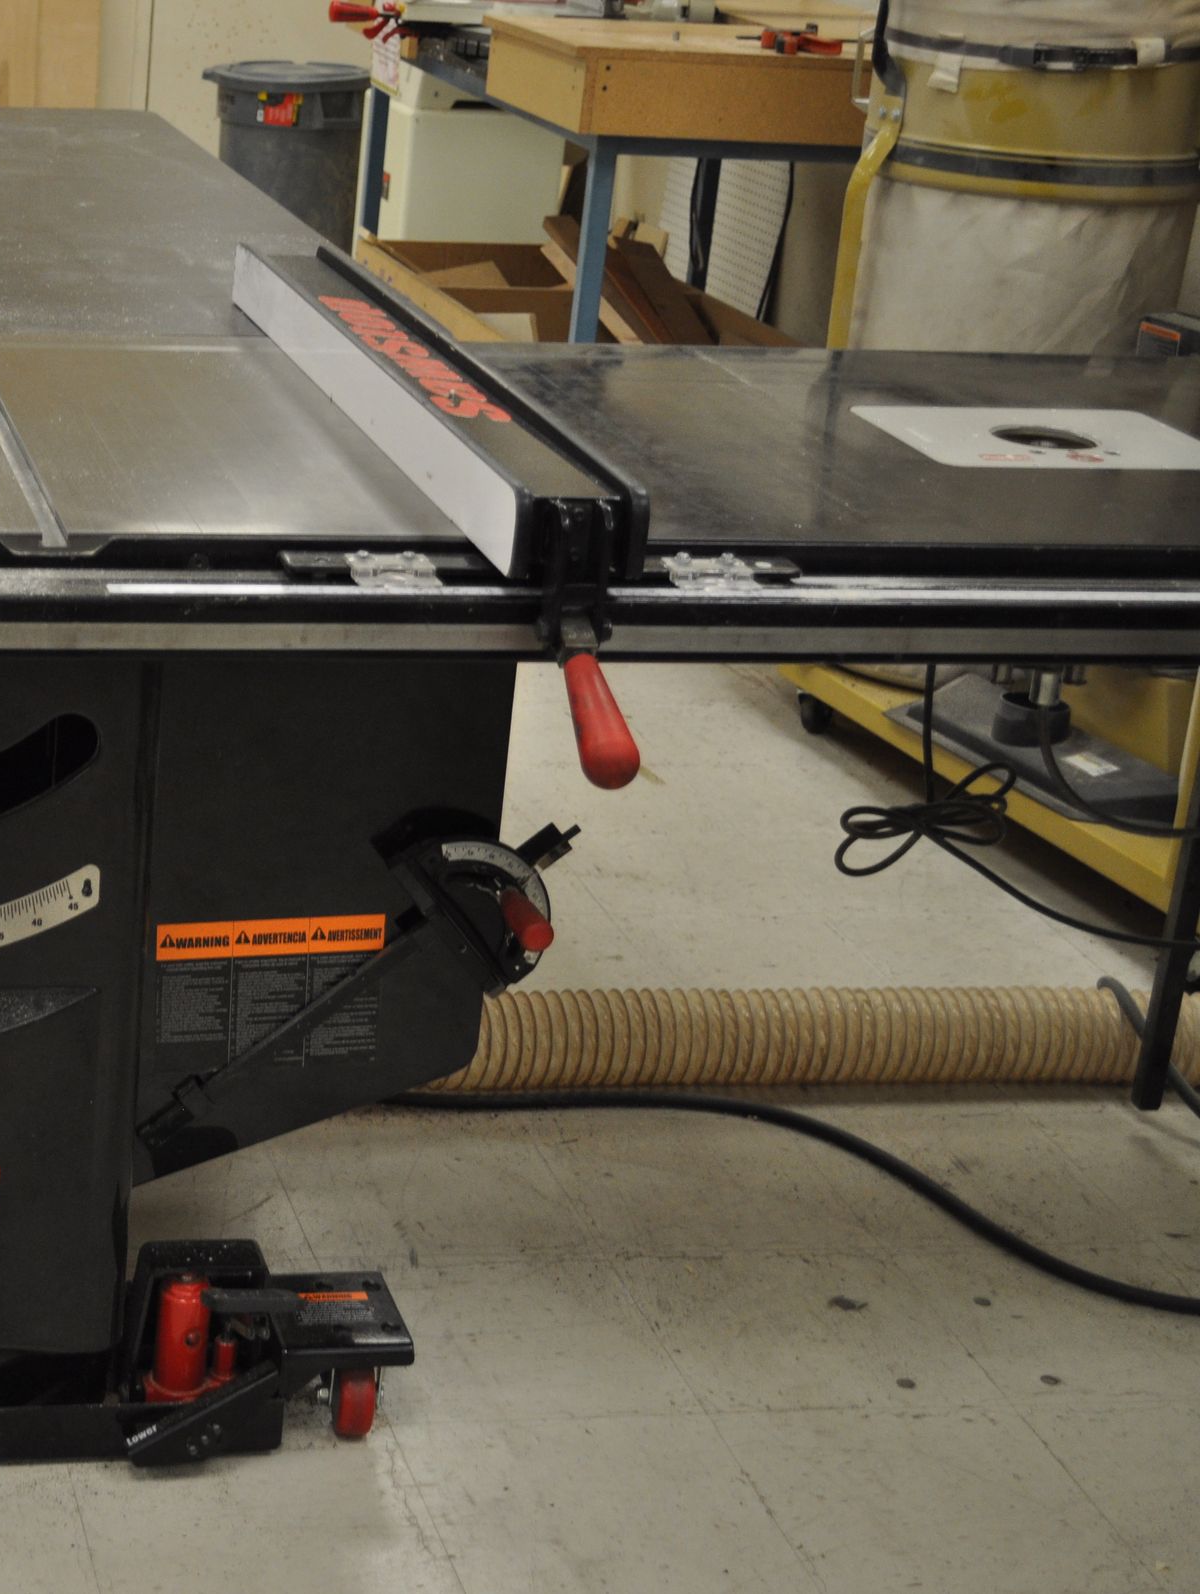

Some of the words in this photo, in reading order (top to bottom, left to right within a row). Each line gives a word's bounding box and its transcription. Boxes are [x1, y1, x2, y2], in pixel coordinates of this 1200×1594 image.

[31, 918, 42, 926] 40
[68, 902, 78, 911] 45
[176, 935, 230, 949] WARNING
[252, 930, 307, 946] ADVERTENCIA
[327, 927, 382, 942] AVERTISSEMENT
[126, 1423, 157, 1447] Lower
